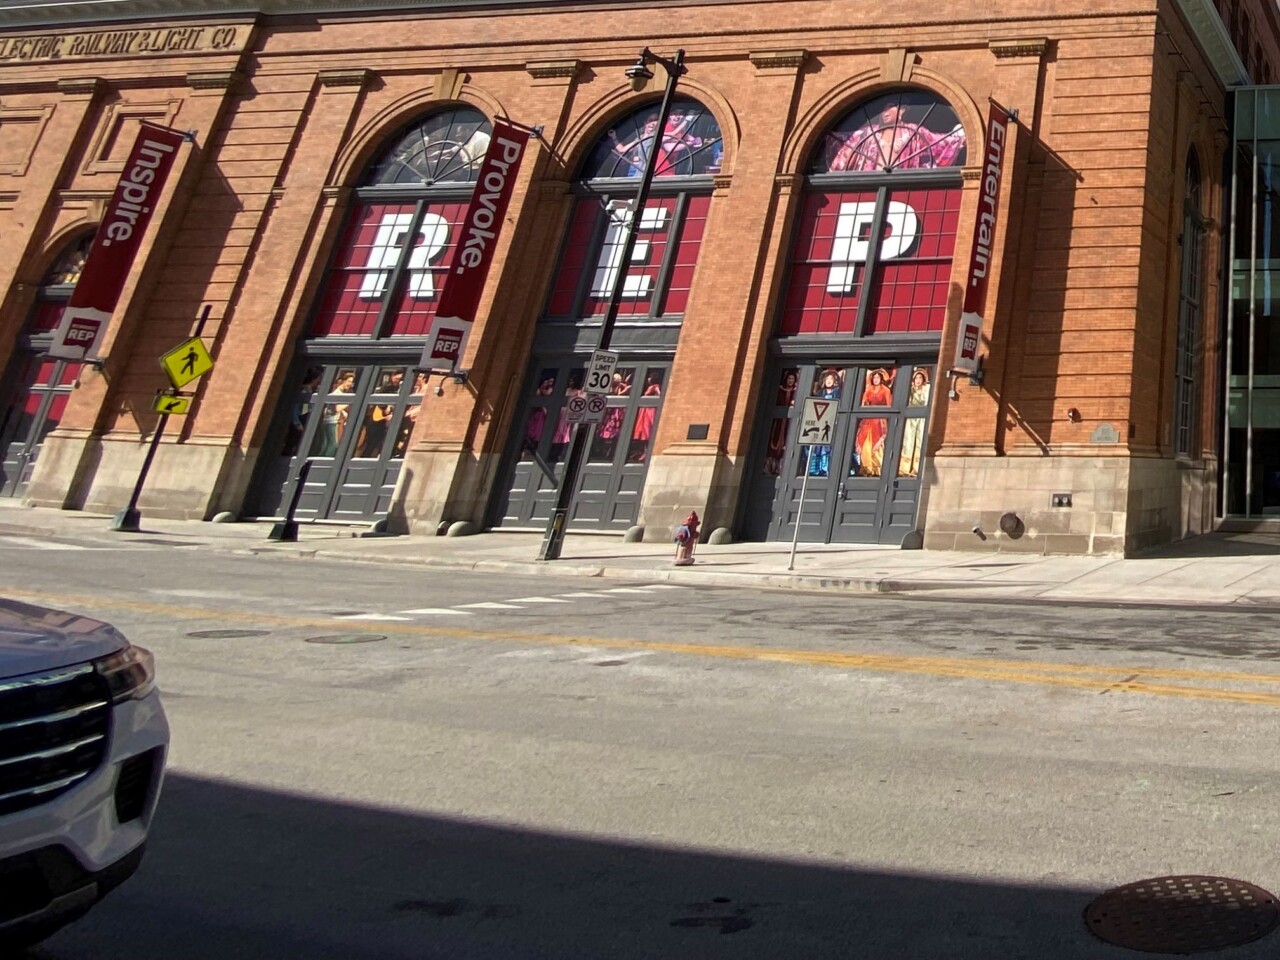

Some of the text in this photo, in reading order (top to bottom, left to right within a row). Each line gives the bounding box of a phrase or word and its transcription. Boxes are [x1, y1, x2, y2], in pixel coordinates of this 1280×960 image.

[0, 34, 65, 59] LECTRIC
[69, 31, 140, 55] RAILWAY
[102, 139, 174, 247] Inspire.
[972, 119, 1006, 287] Entertain.
[456, 137, 521, 275] Provoke.
[359, 213, 450, 297] R
[826, 201, 918, 292] P
[67, 328, 95, 341] REP
[963, 338, 976, 351] REP
[434, 340, 459, 353] REP
[595, 354, 616, 363] SPEED
[589, 372, 610, 389] 30
